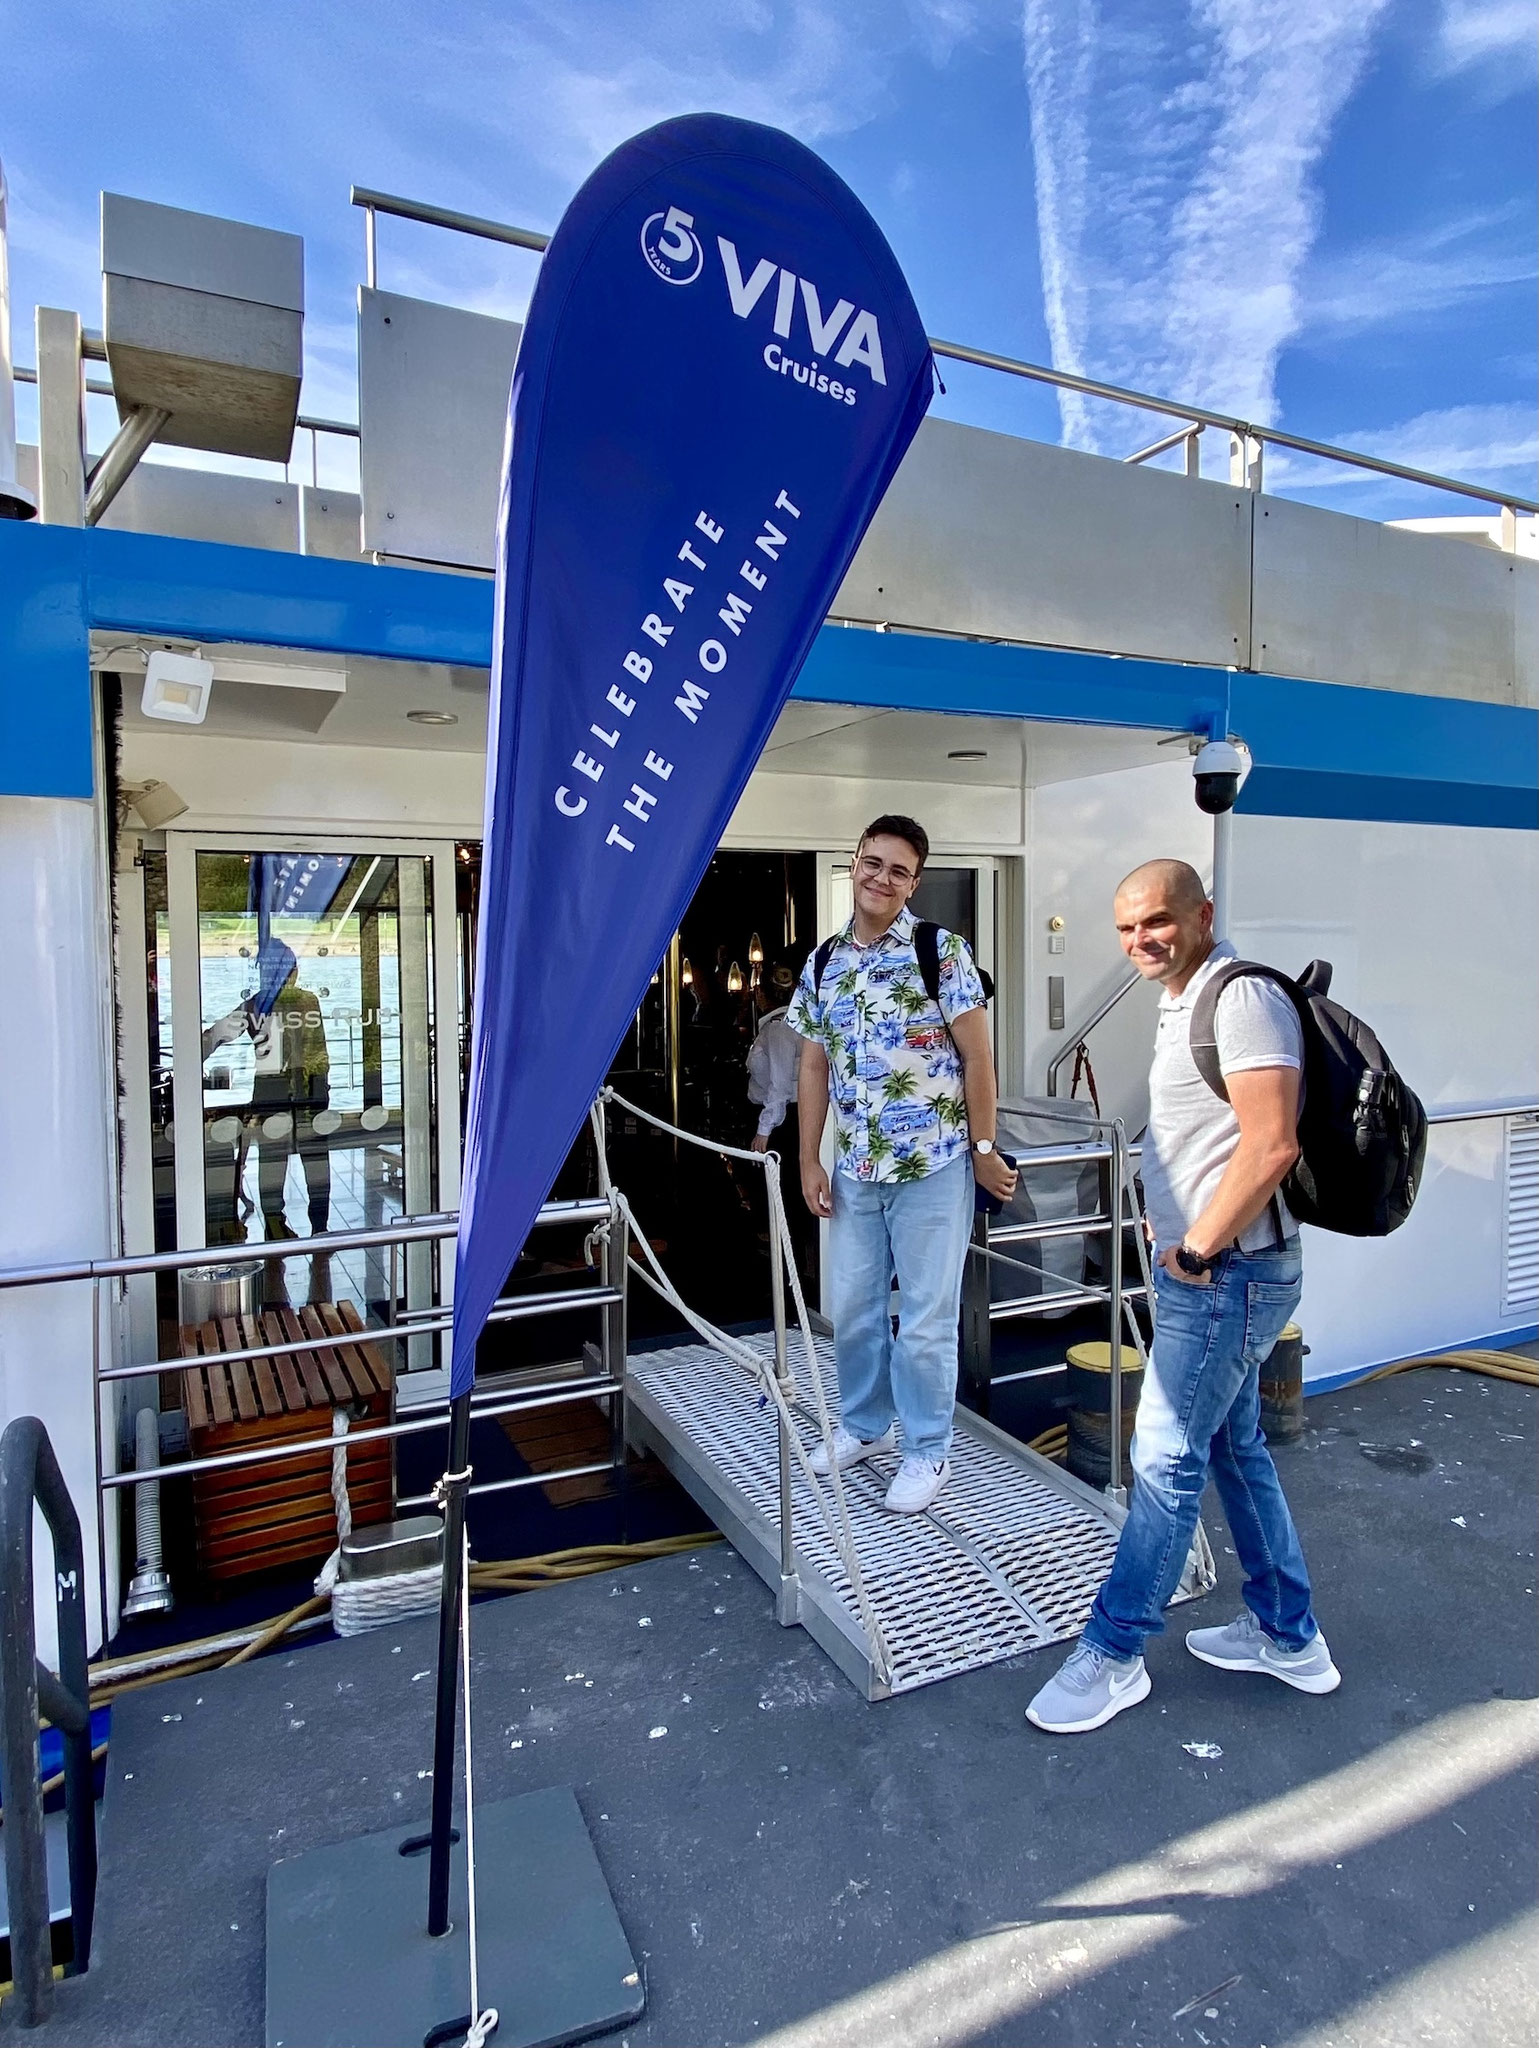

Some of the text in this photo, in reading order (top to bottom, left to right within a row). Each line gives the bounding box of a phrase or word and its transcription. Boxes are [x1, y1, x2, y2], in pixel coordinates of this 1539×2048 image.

[648, 246, 671, 275] YEARS
[658, 205, 695, 262] 5
[717, 235, 887, 386] VIVA
[763, 343, 857, 406] Cruises
[554, 510, 725, 817] CELEBRATE
[605, 489, 801, 852] THE MOMENT
[227, 1010, 322, 1031] SWISS
